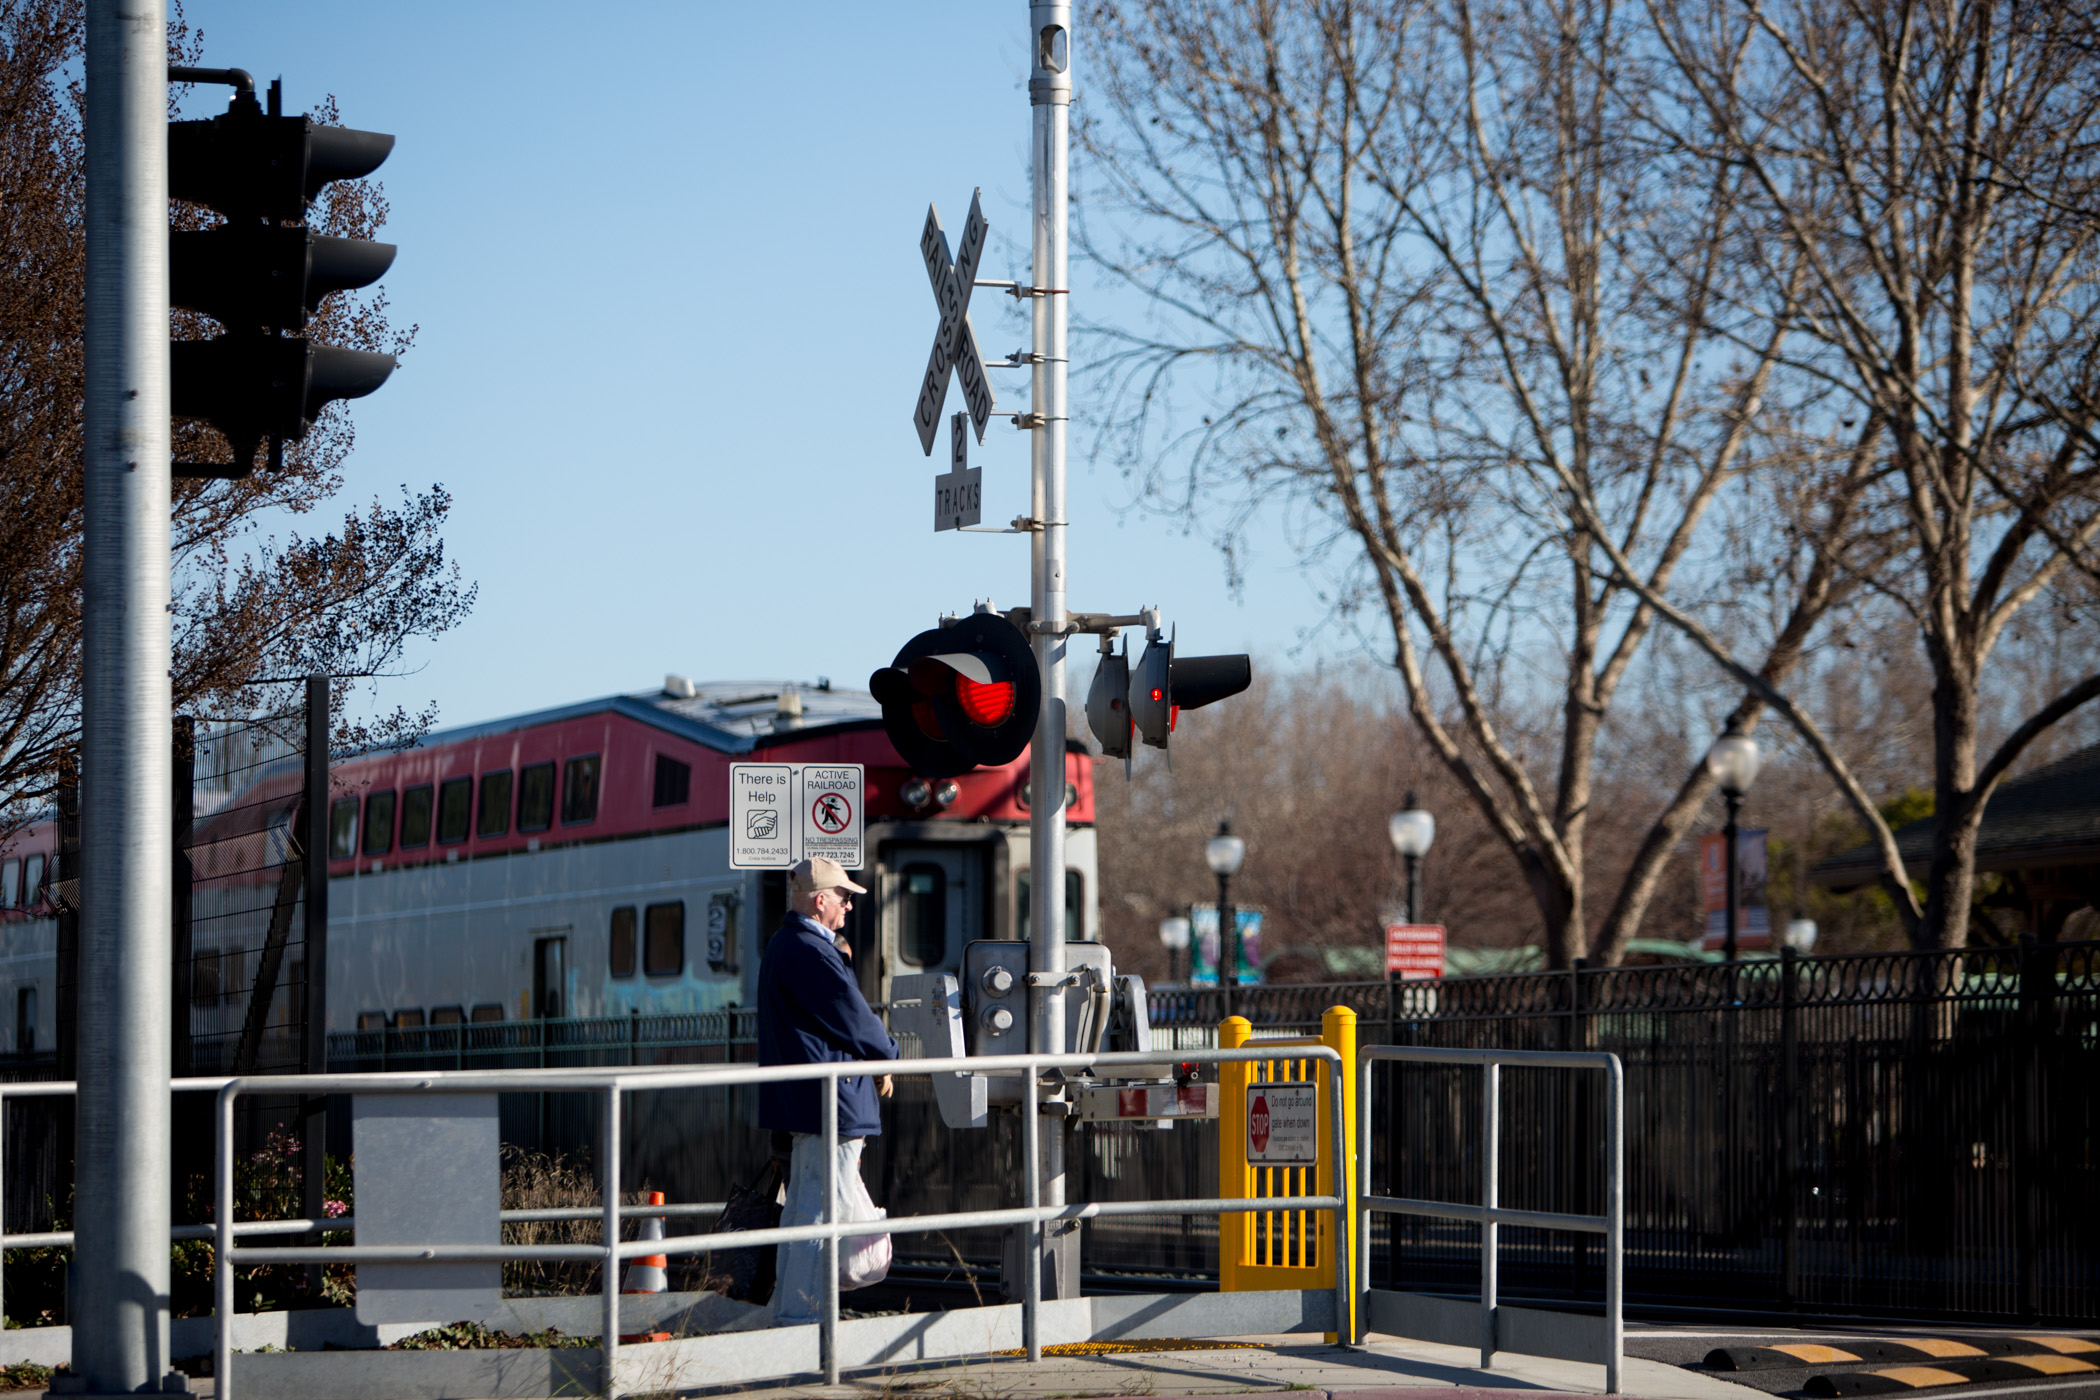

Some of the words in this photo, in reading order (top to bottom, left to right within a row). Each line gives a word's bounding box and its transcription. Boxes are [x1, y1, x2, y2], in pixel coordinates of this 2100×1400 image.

[920, 213, 979, 428] CROSSING
[955, 428, 964, 464] 2
[937, 481, 979, 517] TRACKS
[738, 772, 773, 785] There
[776, 773, 786, 785] is
[814, 770, 849, 780] ACTIVE
[807, 780, 856, 790] RAILROAD
[748, 791, 776, 804] Help
[736, 847, 788, 855] 1.800.784.2433
[708, 908, 722, 957] 29
[1271, 1095, 1278, 1107] Do
[1279, 1096, 1287, 1107] not
[1288, 1097, 1294, 1109] go
[1295, 1095, 1312, 1107] around
[1251, 1113, 1269, 1135] STOP
[1271, 1118, 1282, 1131] gate
[1283, 1116, 1295, 1128] when
[1297, 1116, 1310, 1128] down
